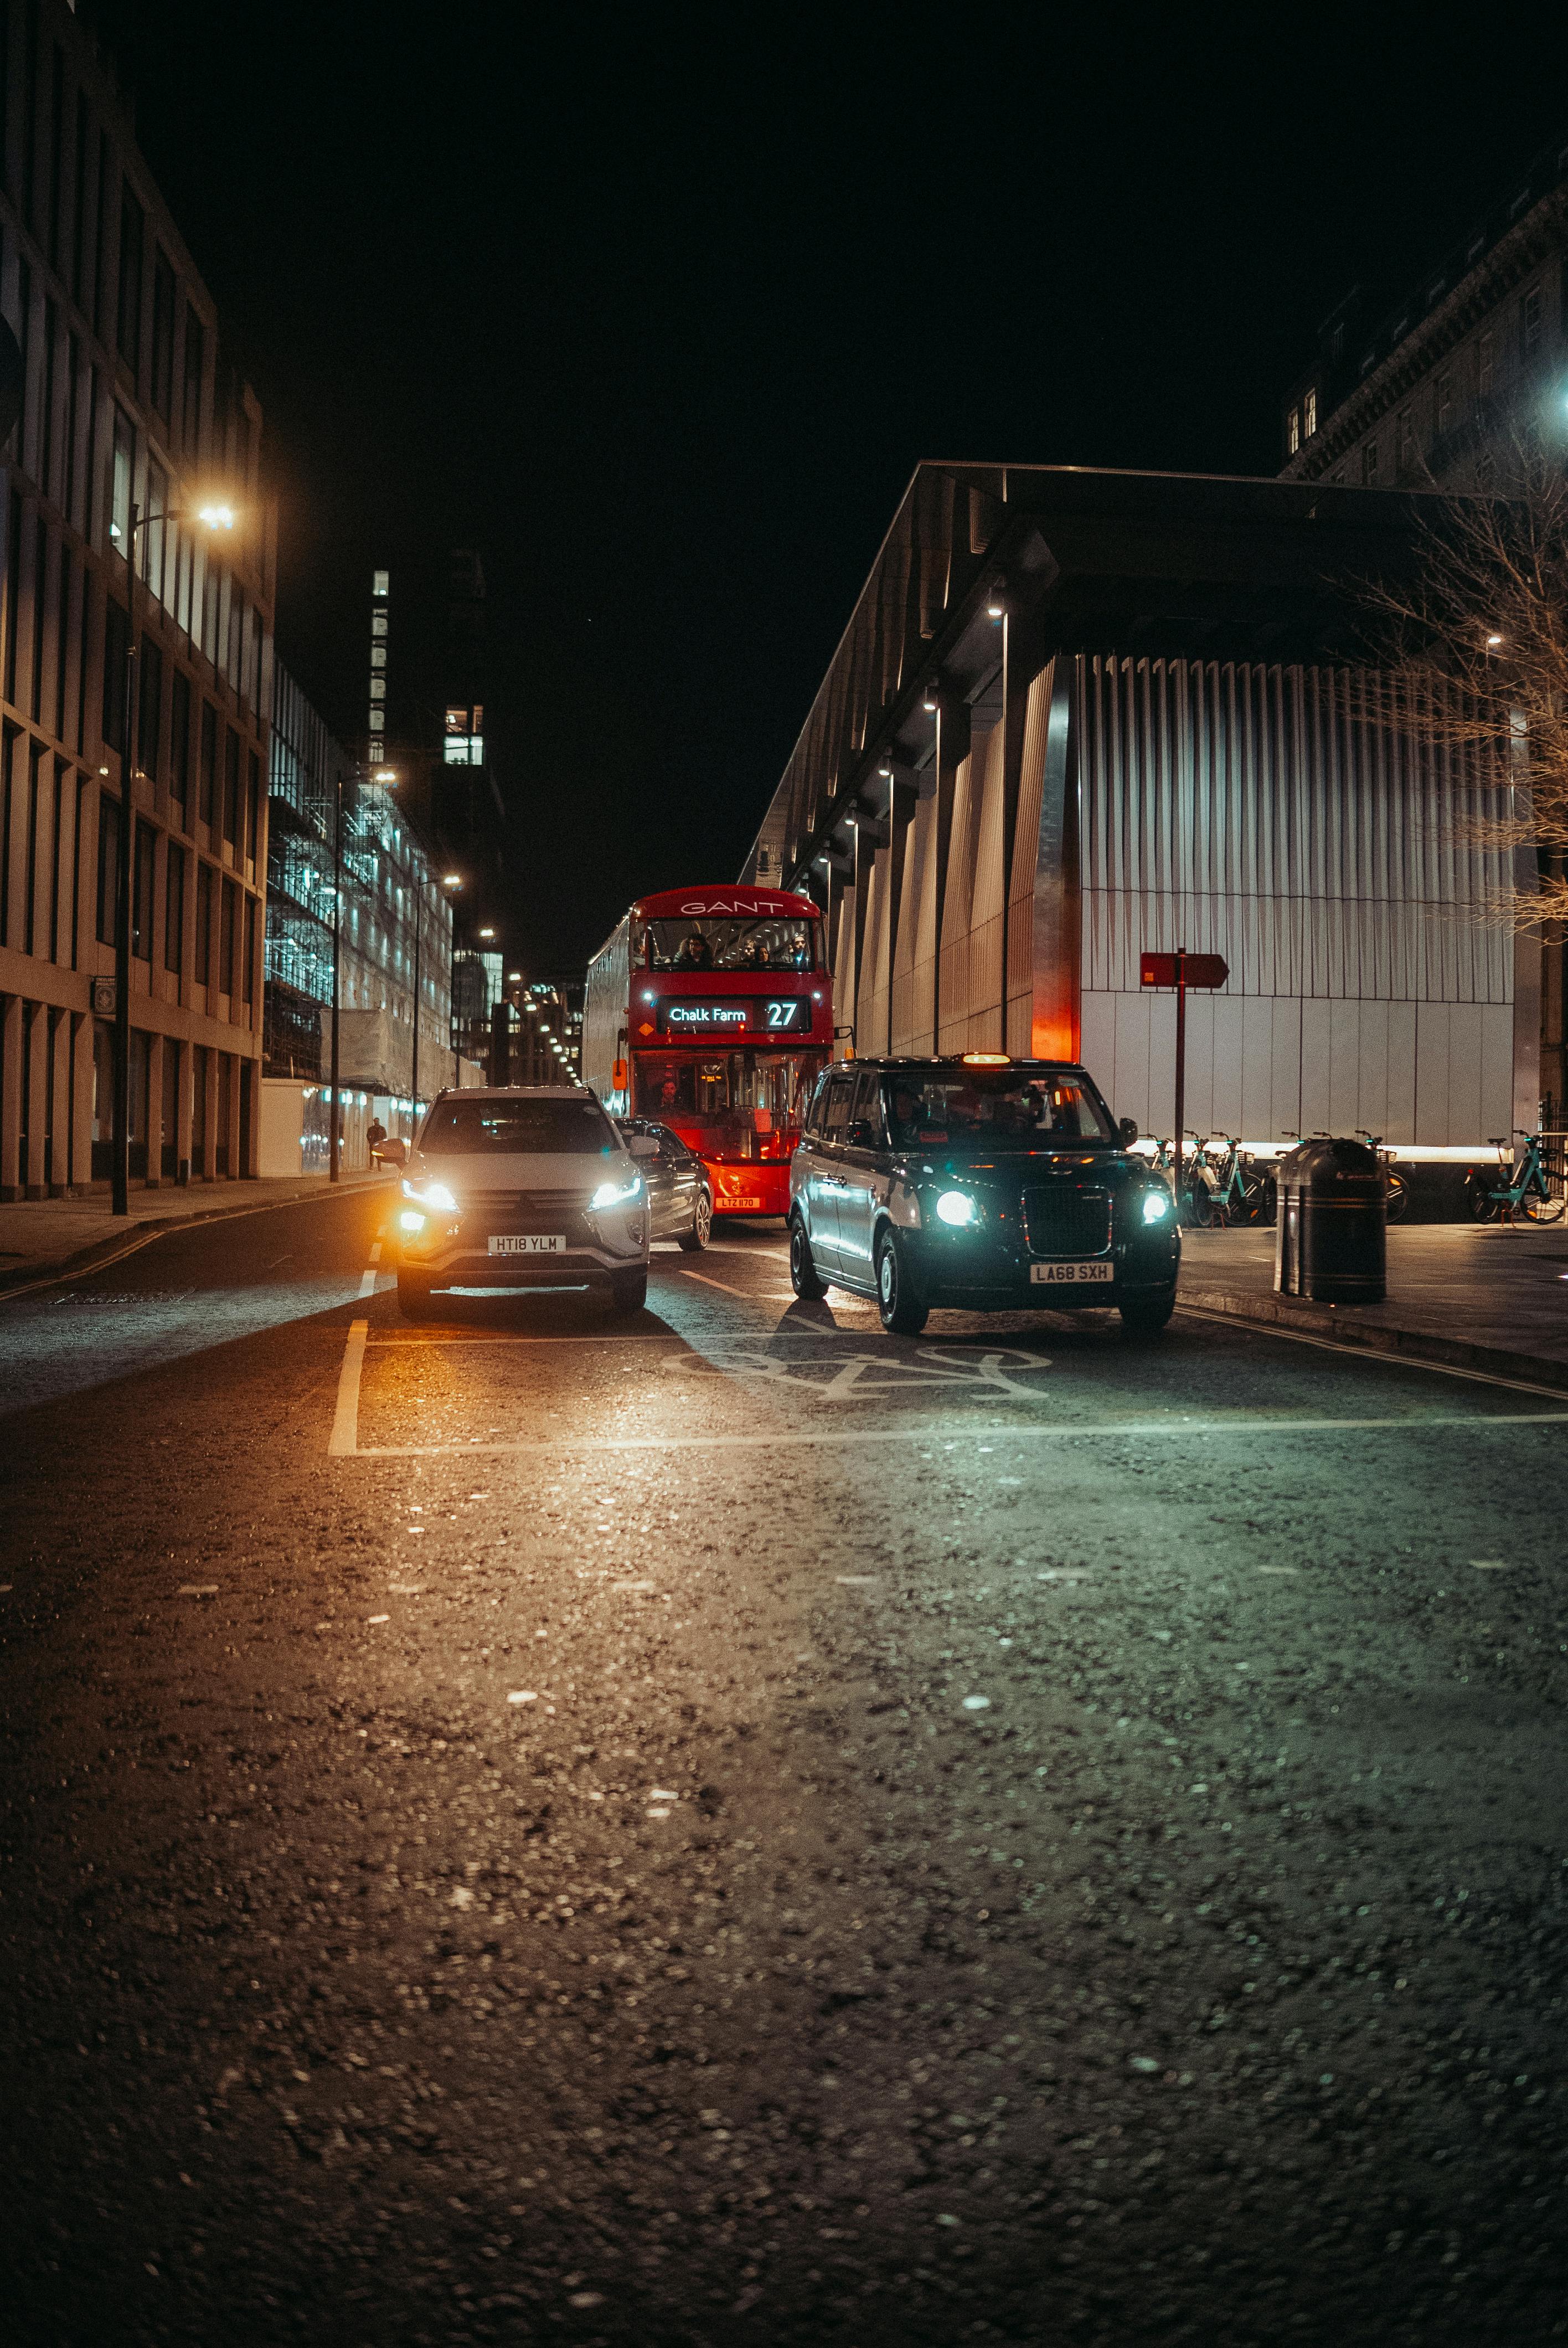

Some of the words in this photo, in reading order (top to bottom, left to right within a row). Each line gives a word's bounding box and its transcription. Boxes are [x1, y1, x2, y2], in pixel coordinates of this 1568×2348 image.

[681, 901, 783, 914] GANT
[670, 1008, 710, 1021] Chalk
[714, 1008, 746, 1021] Farm
[768, 1003, 797, 1026] 27
[497, 1238, 527, 1250] HT18
[531, 1238, 557, 1250] YLM
[1036, 1266, 1074, 1281] LA68
[1079, 1265, 1107, 1279] SXH
